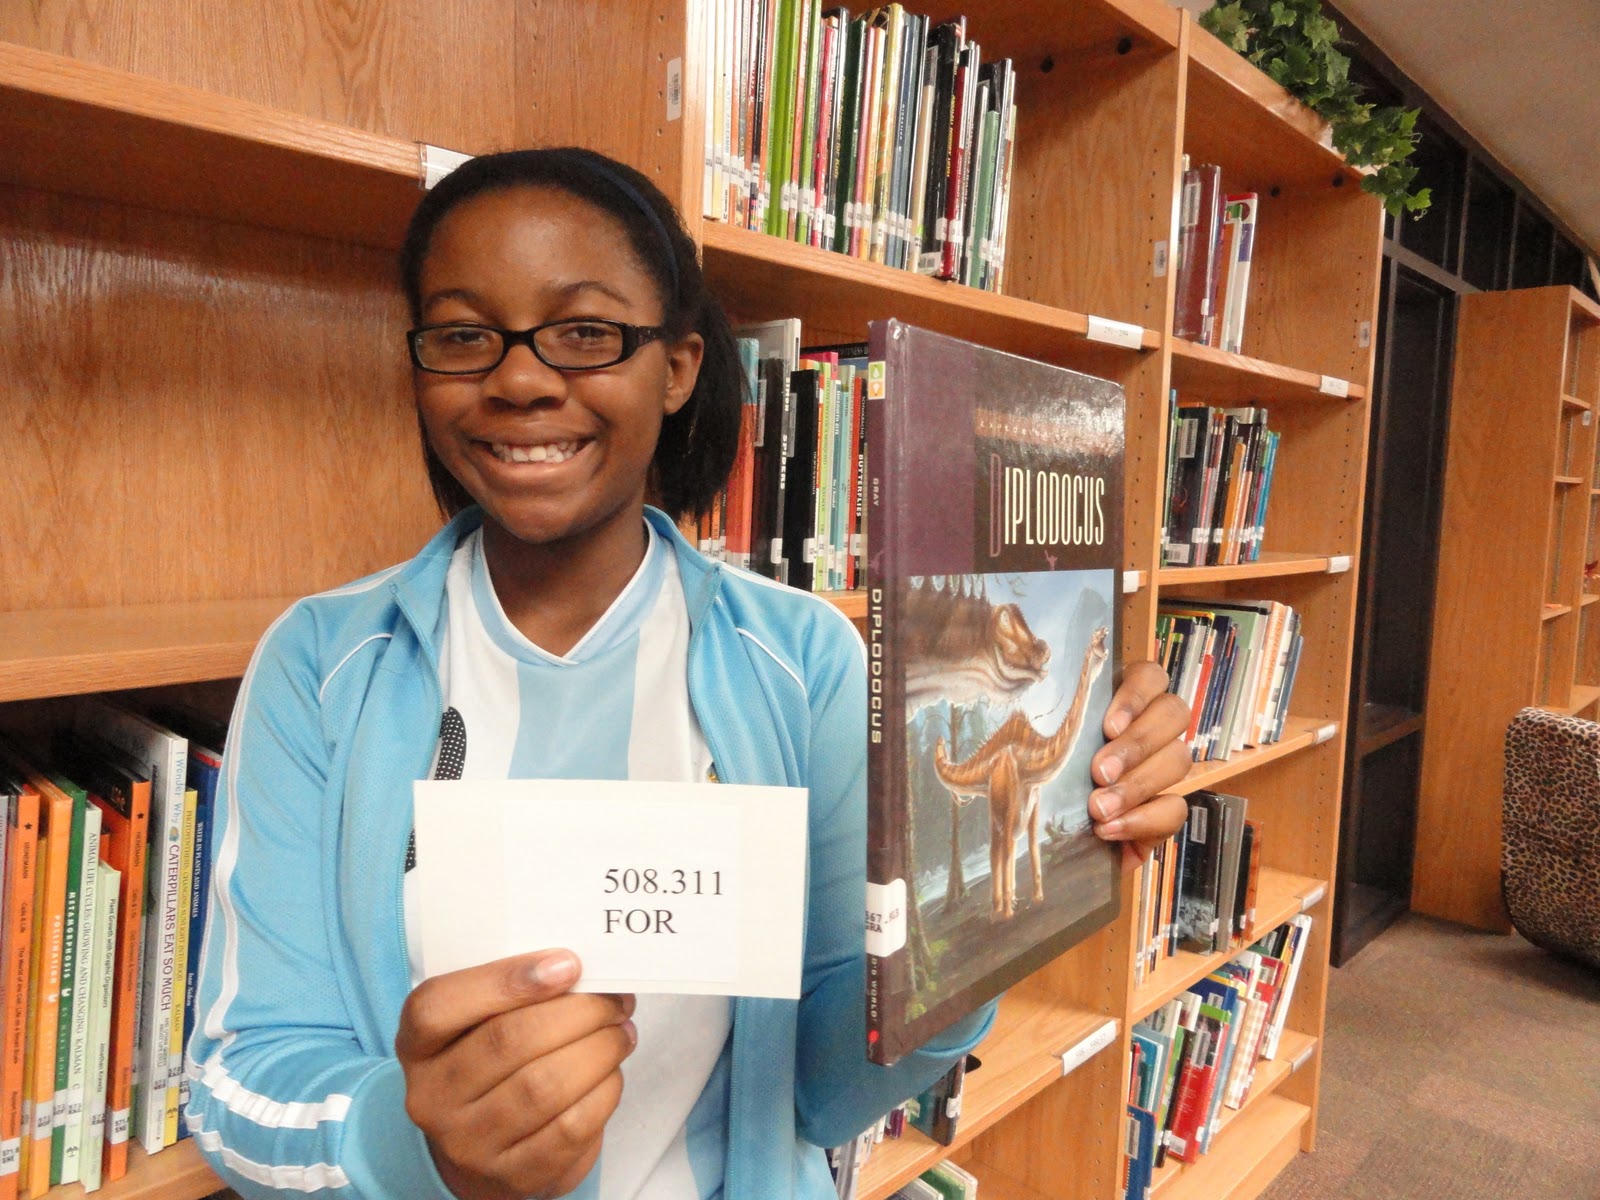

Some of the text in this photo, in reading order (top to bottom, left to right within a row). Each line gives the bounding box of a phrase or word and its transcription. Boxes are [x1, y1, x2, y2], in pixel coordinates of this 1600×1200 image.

[856, 454, 864, 517] BUTTERFLIES
[990, 453, 1104, 558] DIPLODOCUS
[871, 589, 882, 743] DIPLODOCUS
[175, 757, 185, 796] Wonder
[173, 803, 182, 826] Why
[87, 832, 97, 866] ANIMAL
[196, 822, 204, 843] WATER
[86, 868, 95, 885] LIFE
[194, 852, 202, 875] PLANTS
[165, 845, 179, 930] CATERPILLARS
[181, 871, 189, 908] CHANGING
[604, 868, 722, 895] 508.311
[84, 888, 93, 921] CYCLES:
[192, 891, 200, 918] ANIMALS
[63, 892, 76, 978] METAMORPHOSIS
[107, 916, 115, 937] Growth
[178, 910, 187, 943] SUNLIGHT
[604, 909, 678, 934] FOR
[50, 915, 61, 983] POLLINATION
[81, 923, 91, 964] GROWING
[164, 934, 174, 954] EAT
[79, 966, 88, 985] AND
[103, 952, 112, 975] Graphic
[163, 958, 172, 975] SO
[176, 962, 184, 982] FOOD
[102, 977, 110, 1008] Organizers
[160, 978, 173, 1011] MUCH
[870, 981, 878, 1018] WORLD
[76, 986, 87, 1033] CHANGING
[73, 1038, 84, 1075] KALMAN
[98, 1043, 106, 1070] Jonathan
